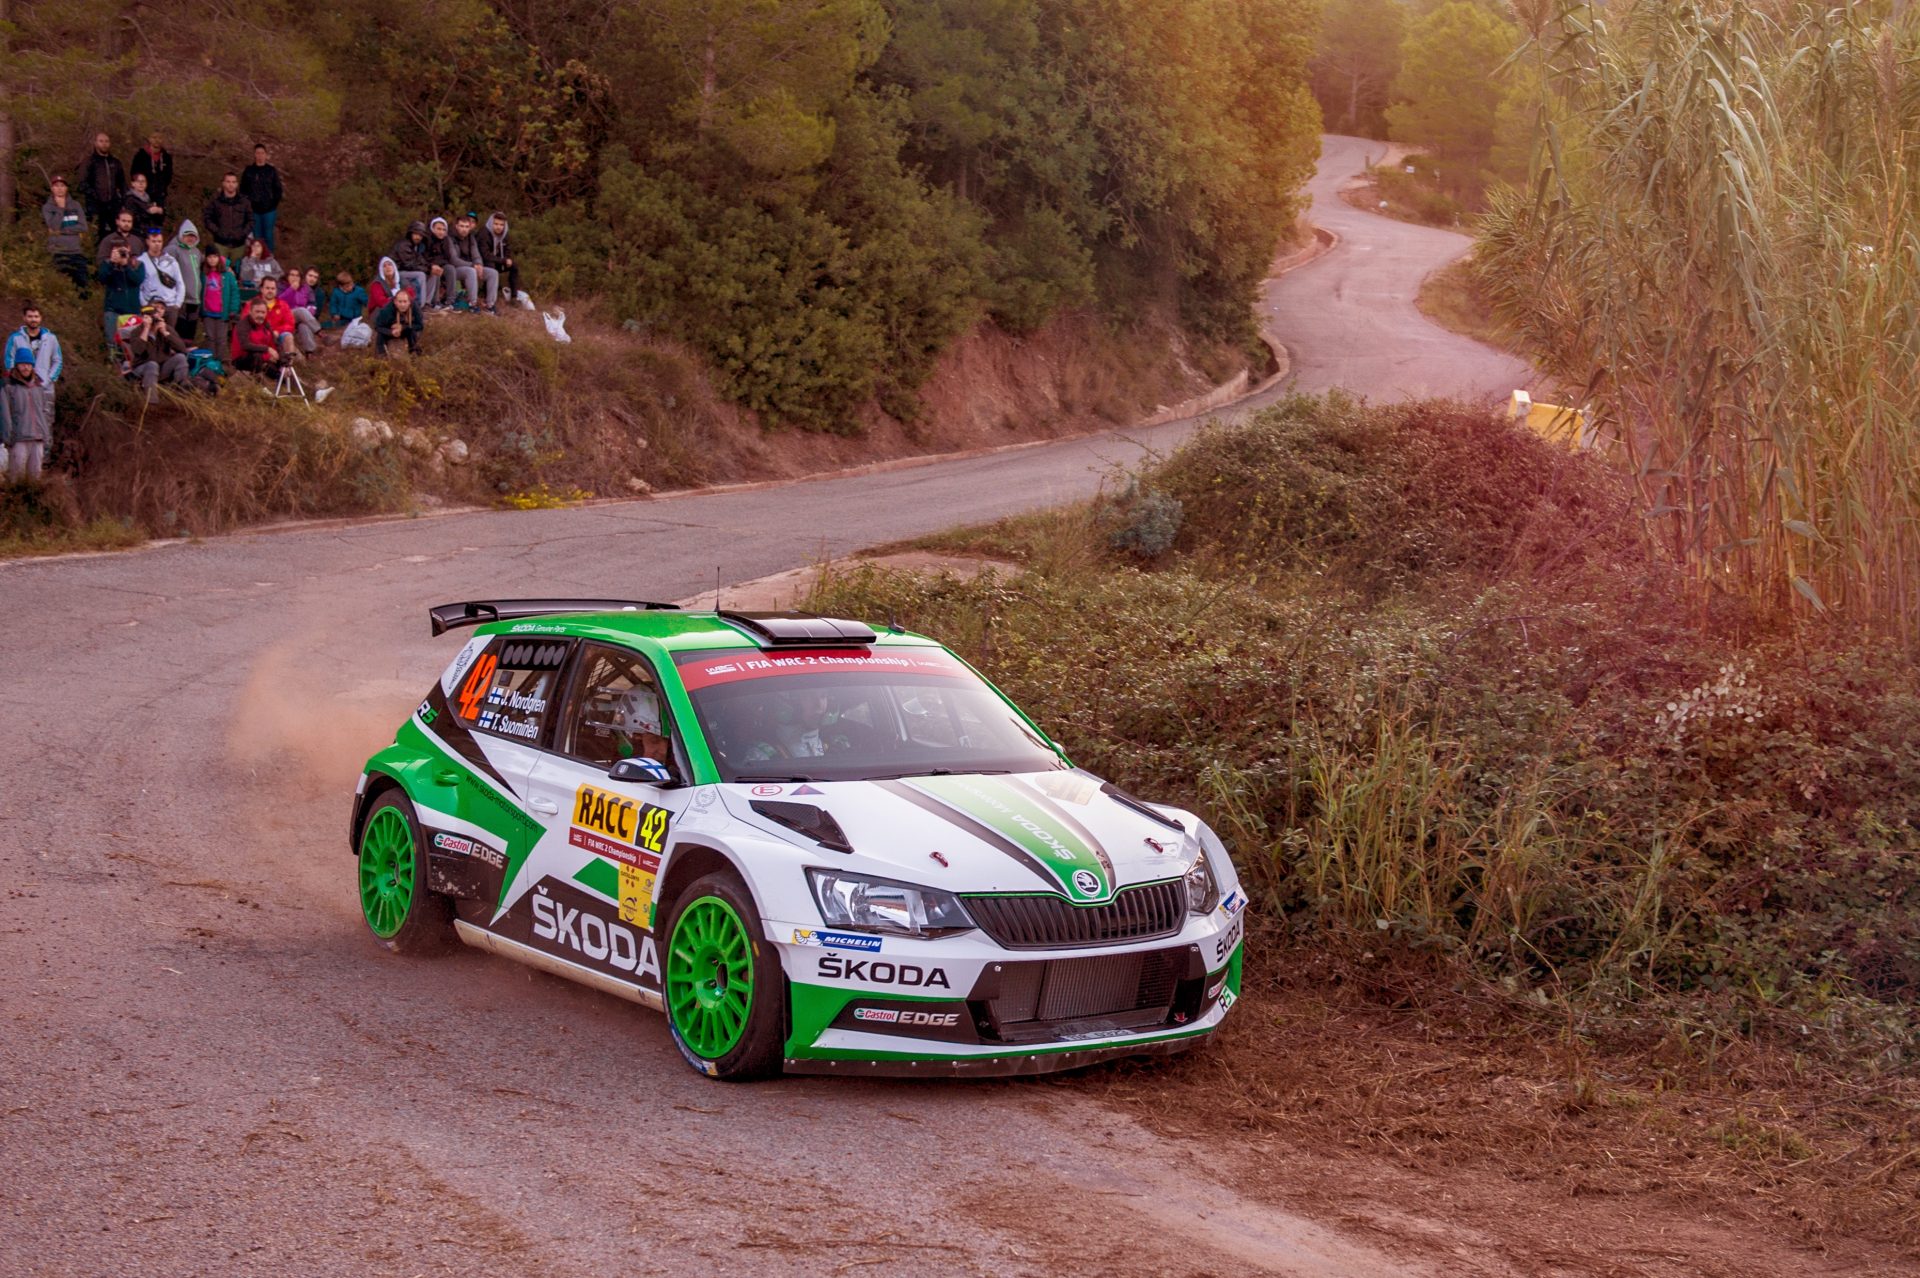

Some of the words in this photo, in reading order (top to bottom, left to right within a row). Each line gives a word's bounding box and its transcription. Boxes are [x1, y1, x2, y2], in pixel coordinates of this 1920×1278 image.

[745, 660, 773, 670] FIA
[771, 656, 804, 667] WRC
[805, 656, 817, 665] 2
[818, 656, 909, 667] Championship
[458, 653, 497, 721] 42
[417, 699, 438, 724] R5
[500, 689, 510, 706] J.
[509, 690, 546, 714] Nordgren
[491, 713, 501, 731] T.
[499, 715, 539, 739] Suominen
[578, 787, 634, 838] RACC
[640, 807, 667, 852] 42
[442, 836, 470, 852] Castrol
[471, 843, 503, 868] EDGE
[608, 845, 637, 863] Championship
[532, 884, 661, 984] ŠKODA
[823, 936, 881, 947] MICHELIN
[817, 952, 951, 989] ŠKODA
[1218, 987, 1232, 1013] R5
[864, 1010, 897, 1021] Castrol
[898, 1011, 960, 1026] EDGE
